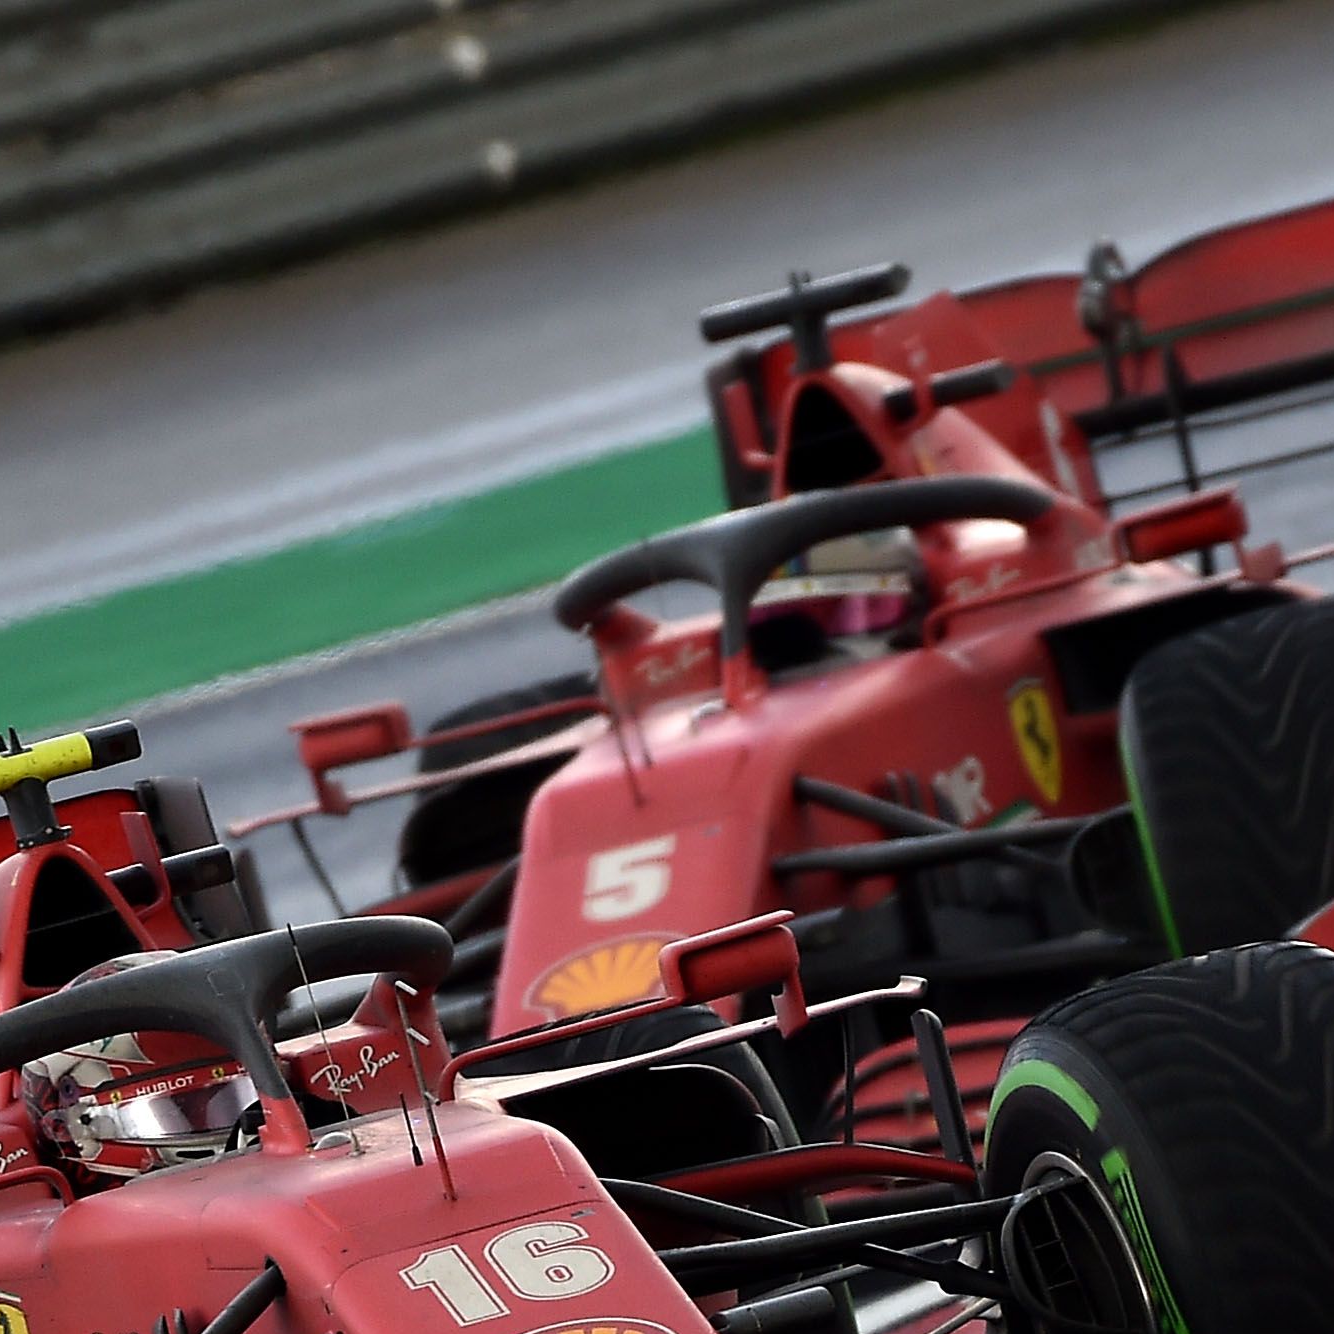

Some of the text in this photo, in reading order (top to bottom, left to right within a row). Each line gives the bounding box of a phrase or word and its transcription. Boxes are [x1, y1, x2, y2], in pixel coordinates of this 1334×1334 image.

[581, 834, 677, 924] 5
[135, 1075, 196, 1097] HUBLOT
[310, 1045, 400, 1096] Ray-Ban
[398, 1220, 616, 1328] 16
